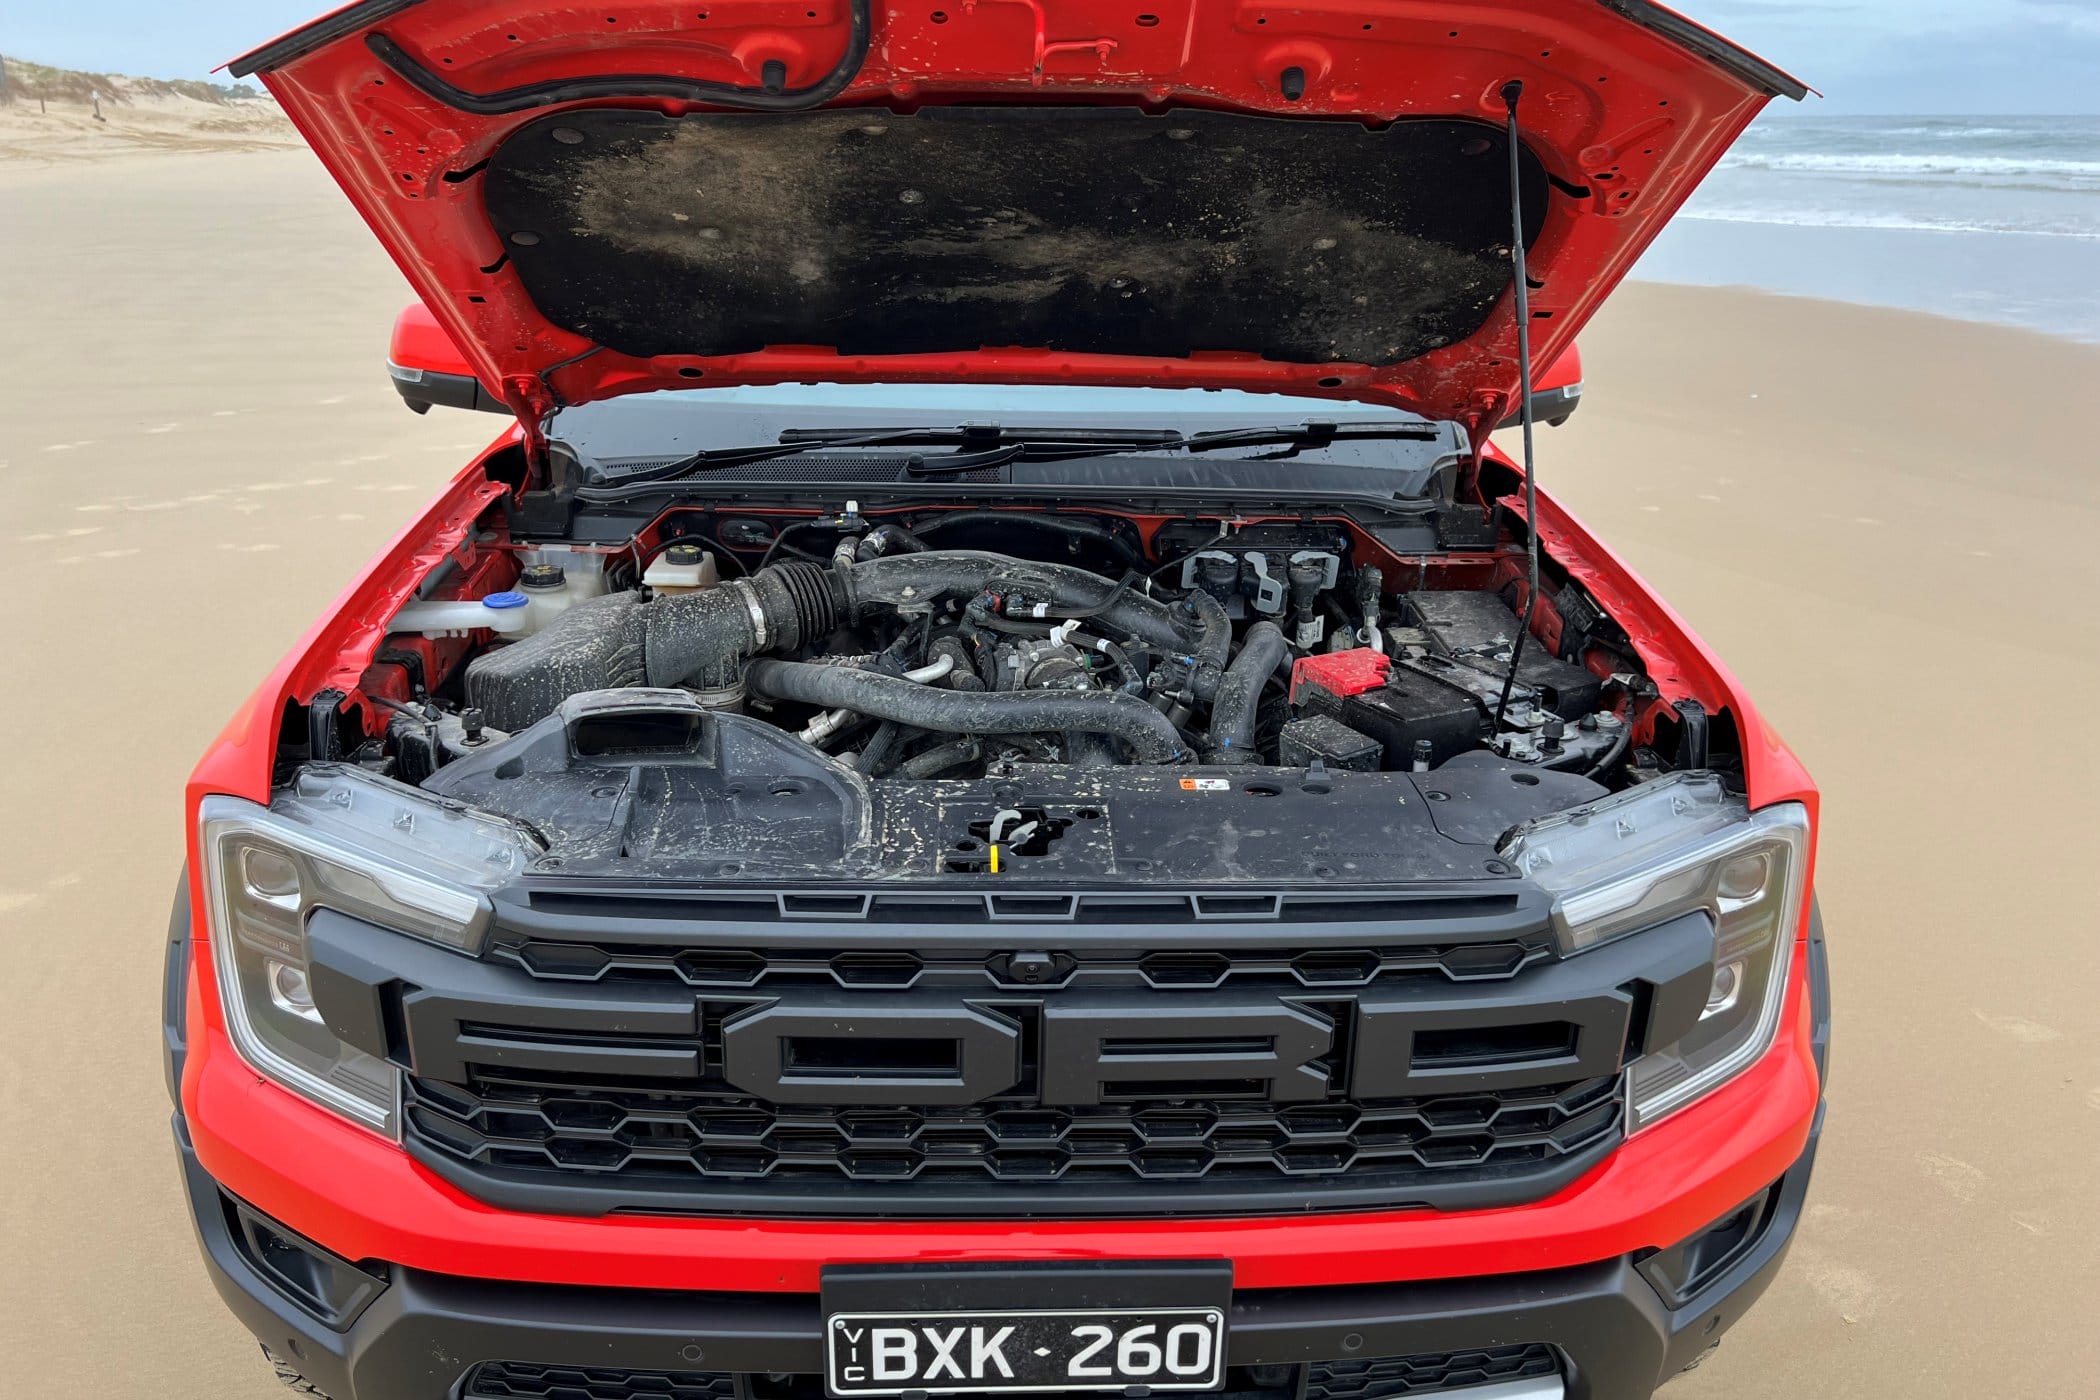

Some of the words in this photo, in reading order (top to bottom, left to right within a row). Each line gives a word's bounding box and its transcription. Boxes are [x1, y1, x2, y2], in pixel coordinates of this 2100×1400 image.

[402, 993, 1633, 1105] FORD
[843, 1328, 865, 1381] VIC
[871, 1326, 1015, 1381] BXK
[1067, 1324, 1211, 1377] 260
